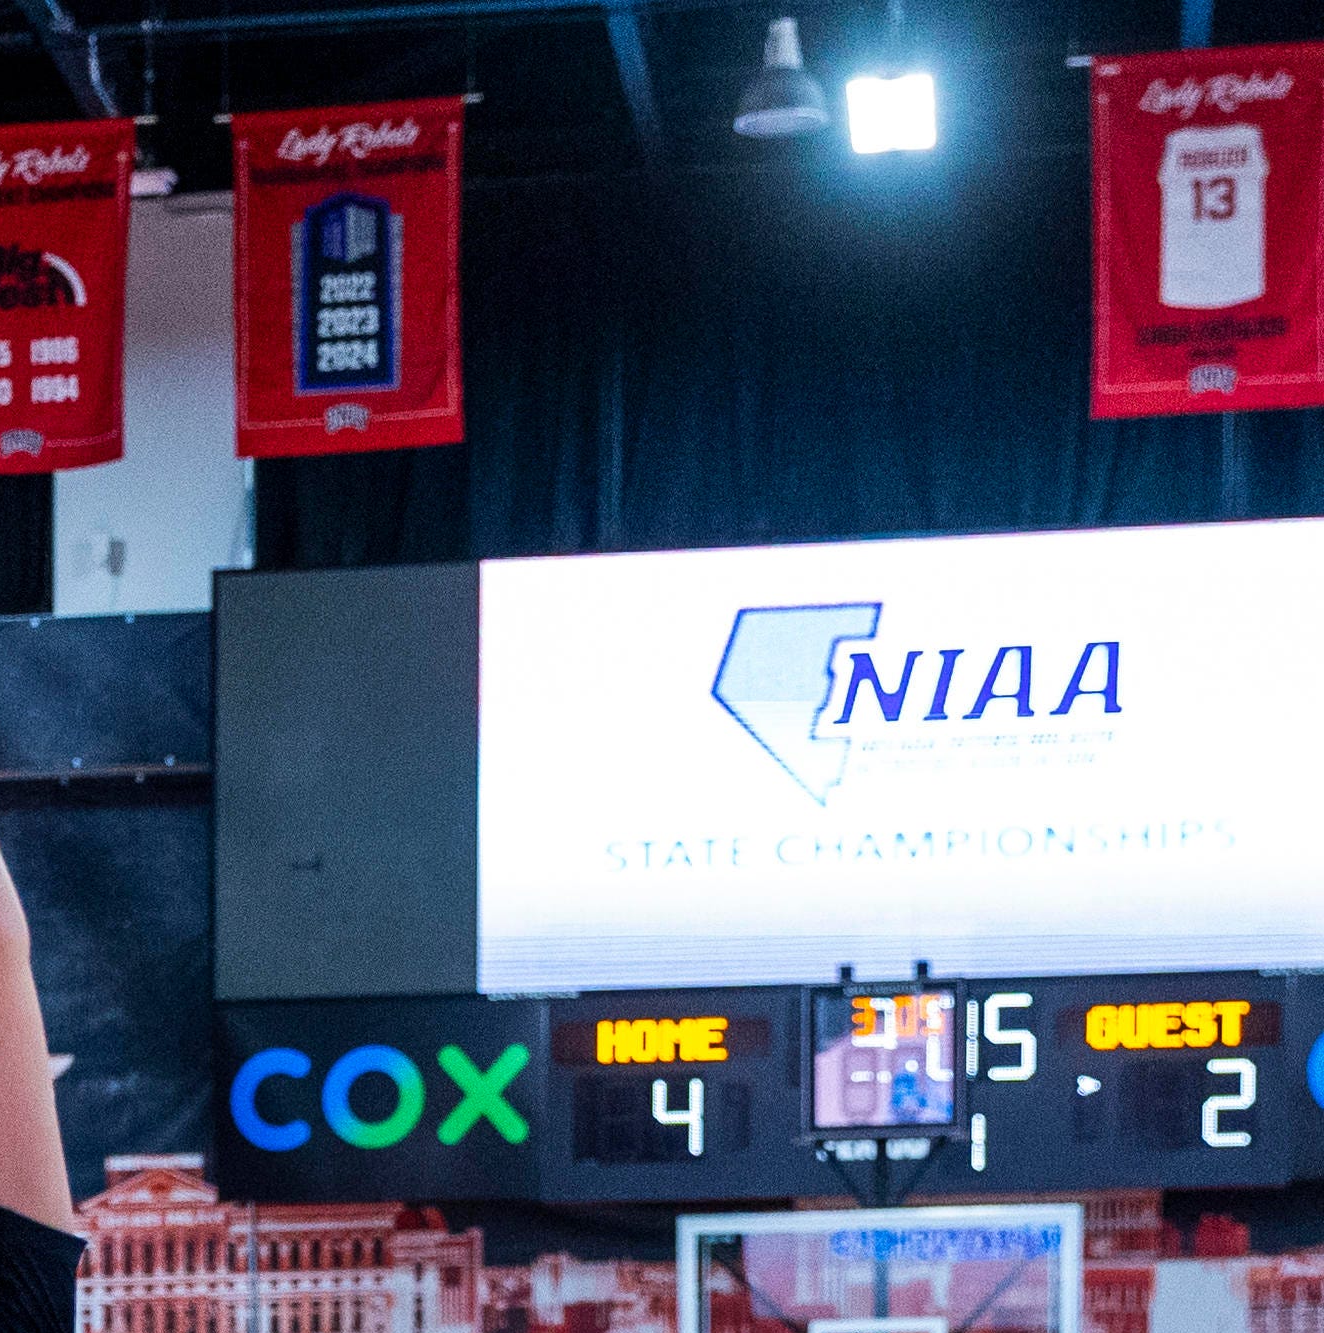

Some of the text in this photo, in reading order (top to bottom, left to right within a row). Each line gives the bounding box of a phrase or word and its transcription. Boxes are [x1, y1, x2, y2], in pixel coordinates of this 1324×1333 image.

[11, 145, 92, 185] Rebels
[1193, 173, 1237, 223] 13
[833, 642, 1123, 724] NIAA
[606, 818, 1236, 873] STATE CHAMPIONSHIPS
[596, 1017, 728, 1064] HOME
[1085, 1001, 1250, 1050] GUEST
[230, 1042, 530, 1152] COX
[652, 1078, 704, 1156] 4
[1202, 1058, 1256, 1147] 2
[971, 1113, 987, 1172] 1
